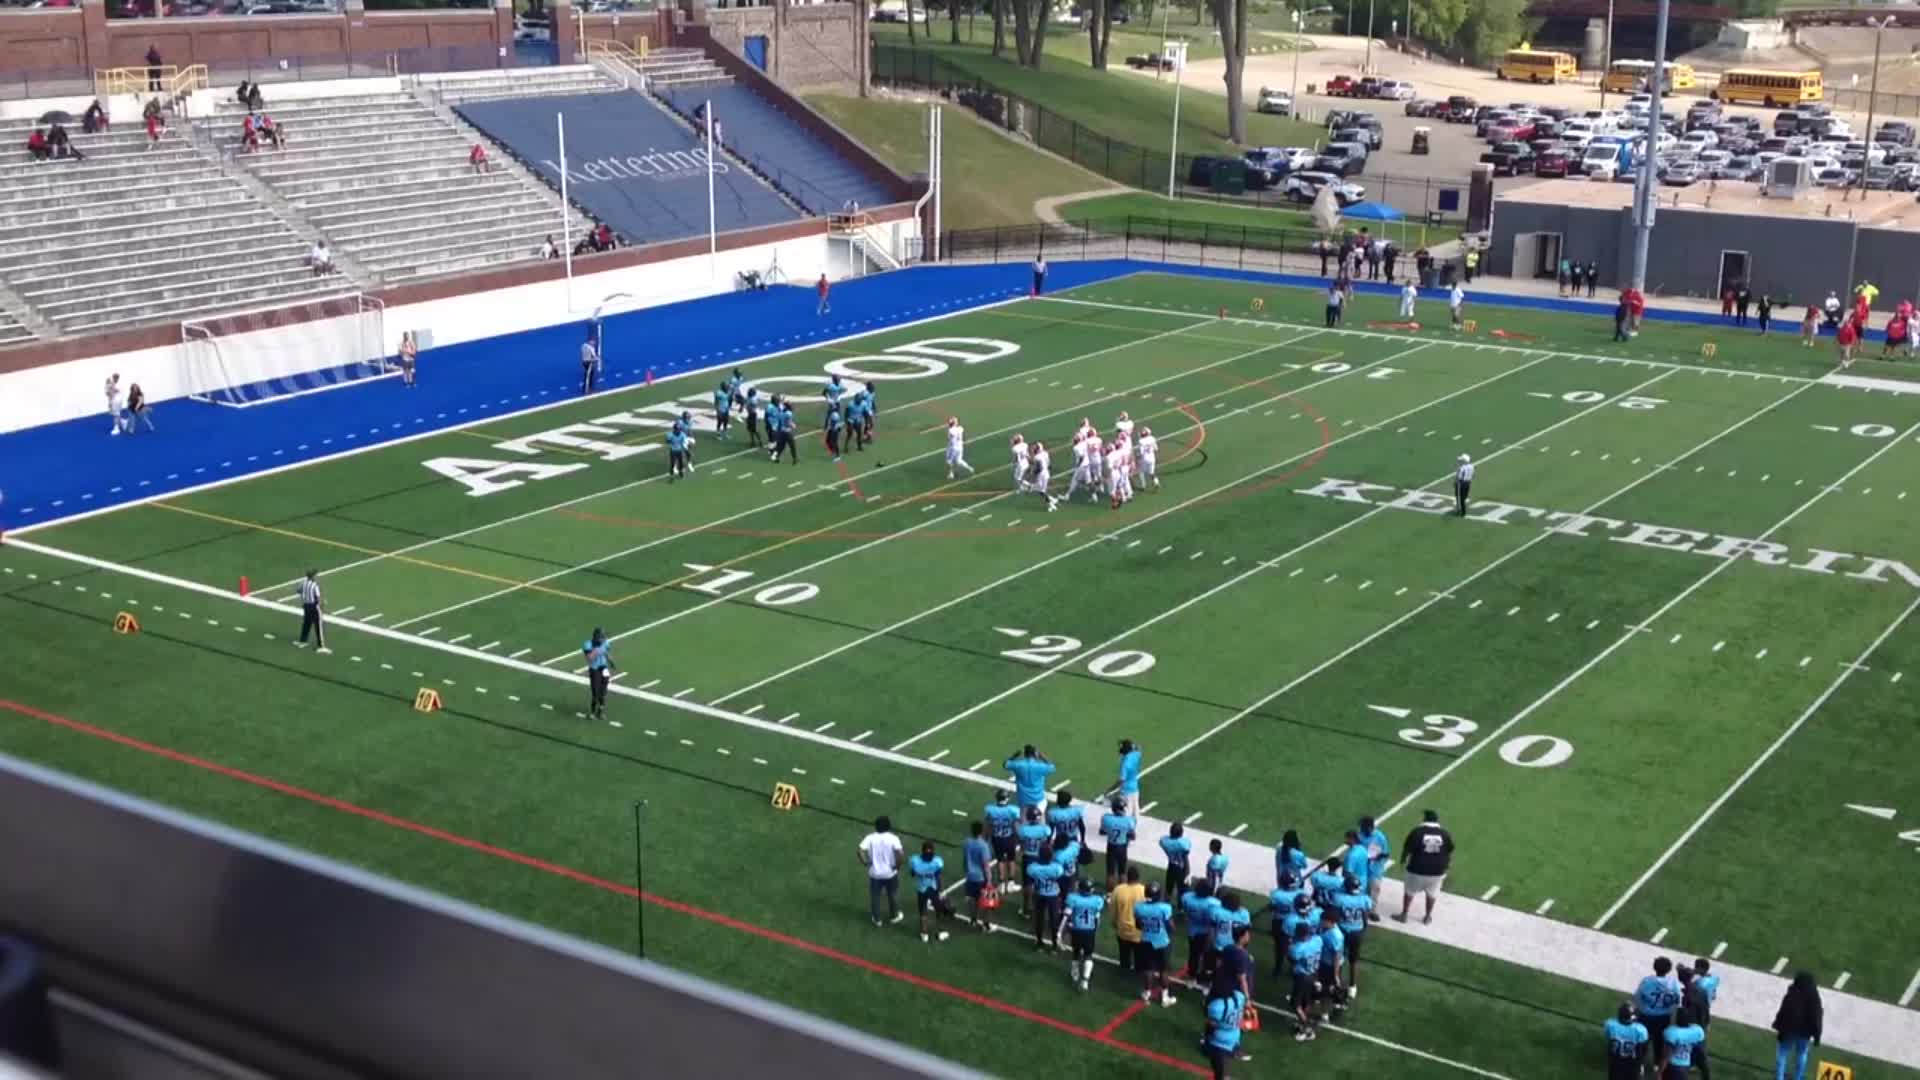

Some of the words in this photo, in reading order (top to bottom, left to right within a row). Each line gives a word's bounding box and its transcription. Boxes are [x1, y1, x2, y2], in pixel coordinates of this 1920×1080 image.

[541, 147, 728, 183] Kettering
[1001, 634, 1156, 677] 20
[1399, 714, 1574, 768] 30
[774, 786, 791, 807] 20
